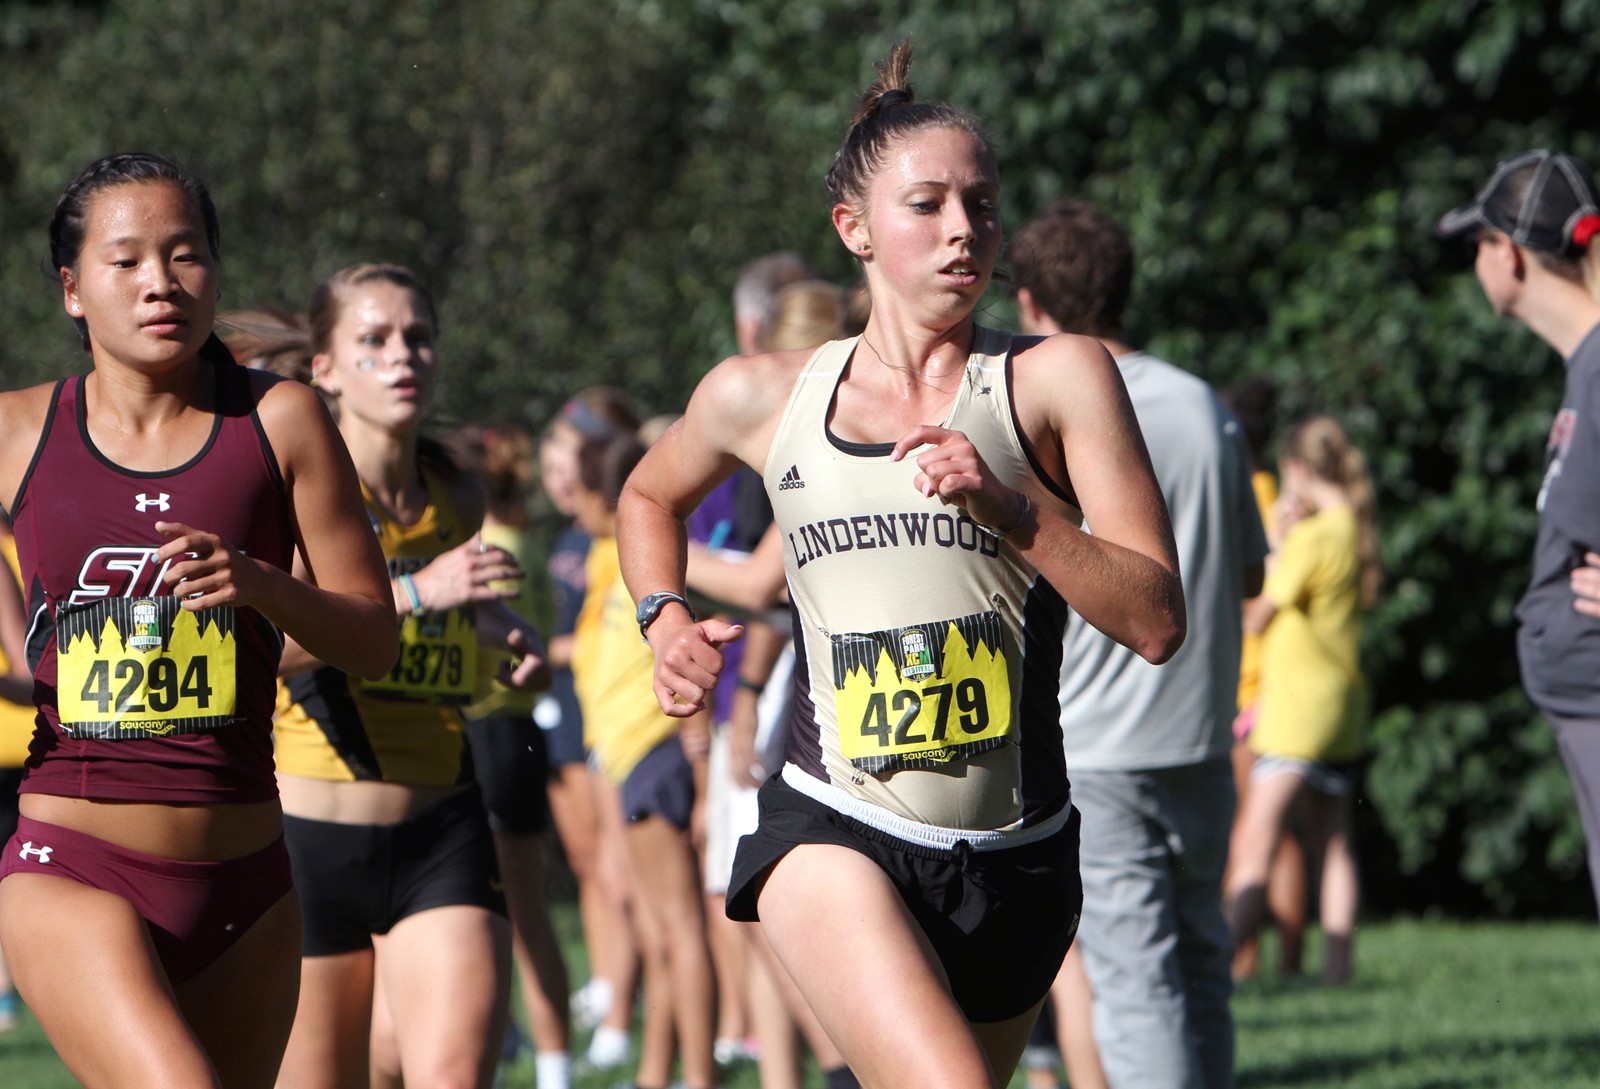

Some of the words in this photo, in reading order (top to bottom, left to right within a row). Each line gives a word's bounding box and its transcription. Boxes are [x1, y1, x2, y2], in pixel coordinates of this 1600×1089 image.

[779, 479, 805, 491] adidas
[789, 512, 998, 569] LINDENWOOD
[134, 614, 155, 624] PARK
[902, 633, 924, 646] FOREST
[904, 642, 925, 655] PARK
[81, 655, 213, 714] 4294
[860, 677, 990, 748] 4279
[119, 720, 165, 731] saucony
[902, 748, 948, 762] saucony
